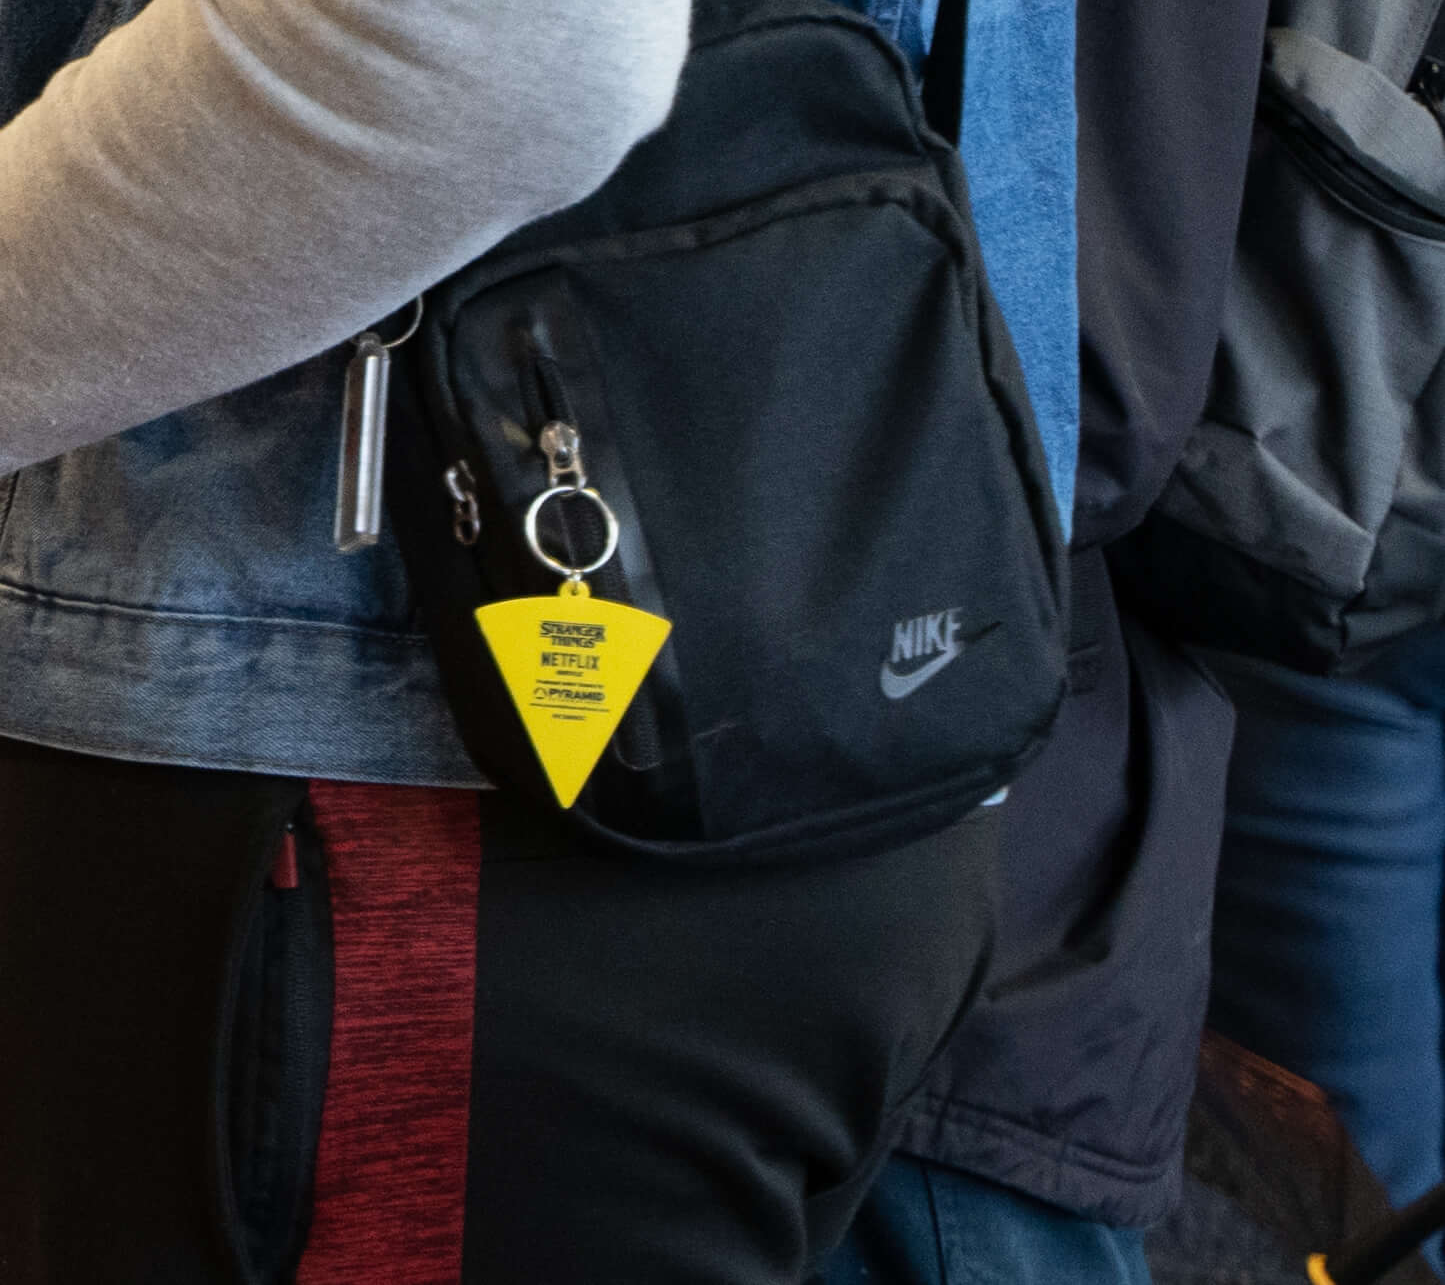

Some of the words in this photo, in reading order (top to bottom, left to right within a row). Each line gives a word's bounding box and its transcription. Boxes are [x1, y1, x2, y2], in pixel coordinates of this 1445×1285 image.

[539, 620, 606, 642] STRANGER
[891, 606, 963, 663] NIKE
[551, 635, 595, 648] THINGS
[541, 651, 600, 671] NETFLIX
[548, 688, 605, 702] PYRAMID
